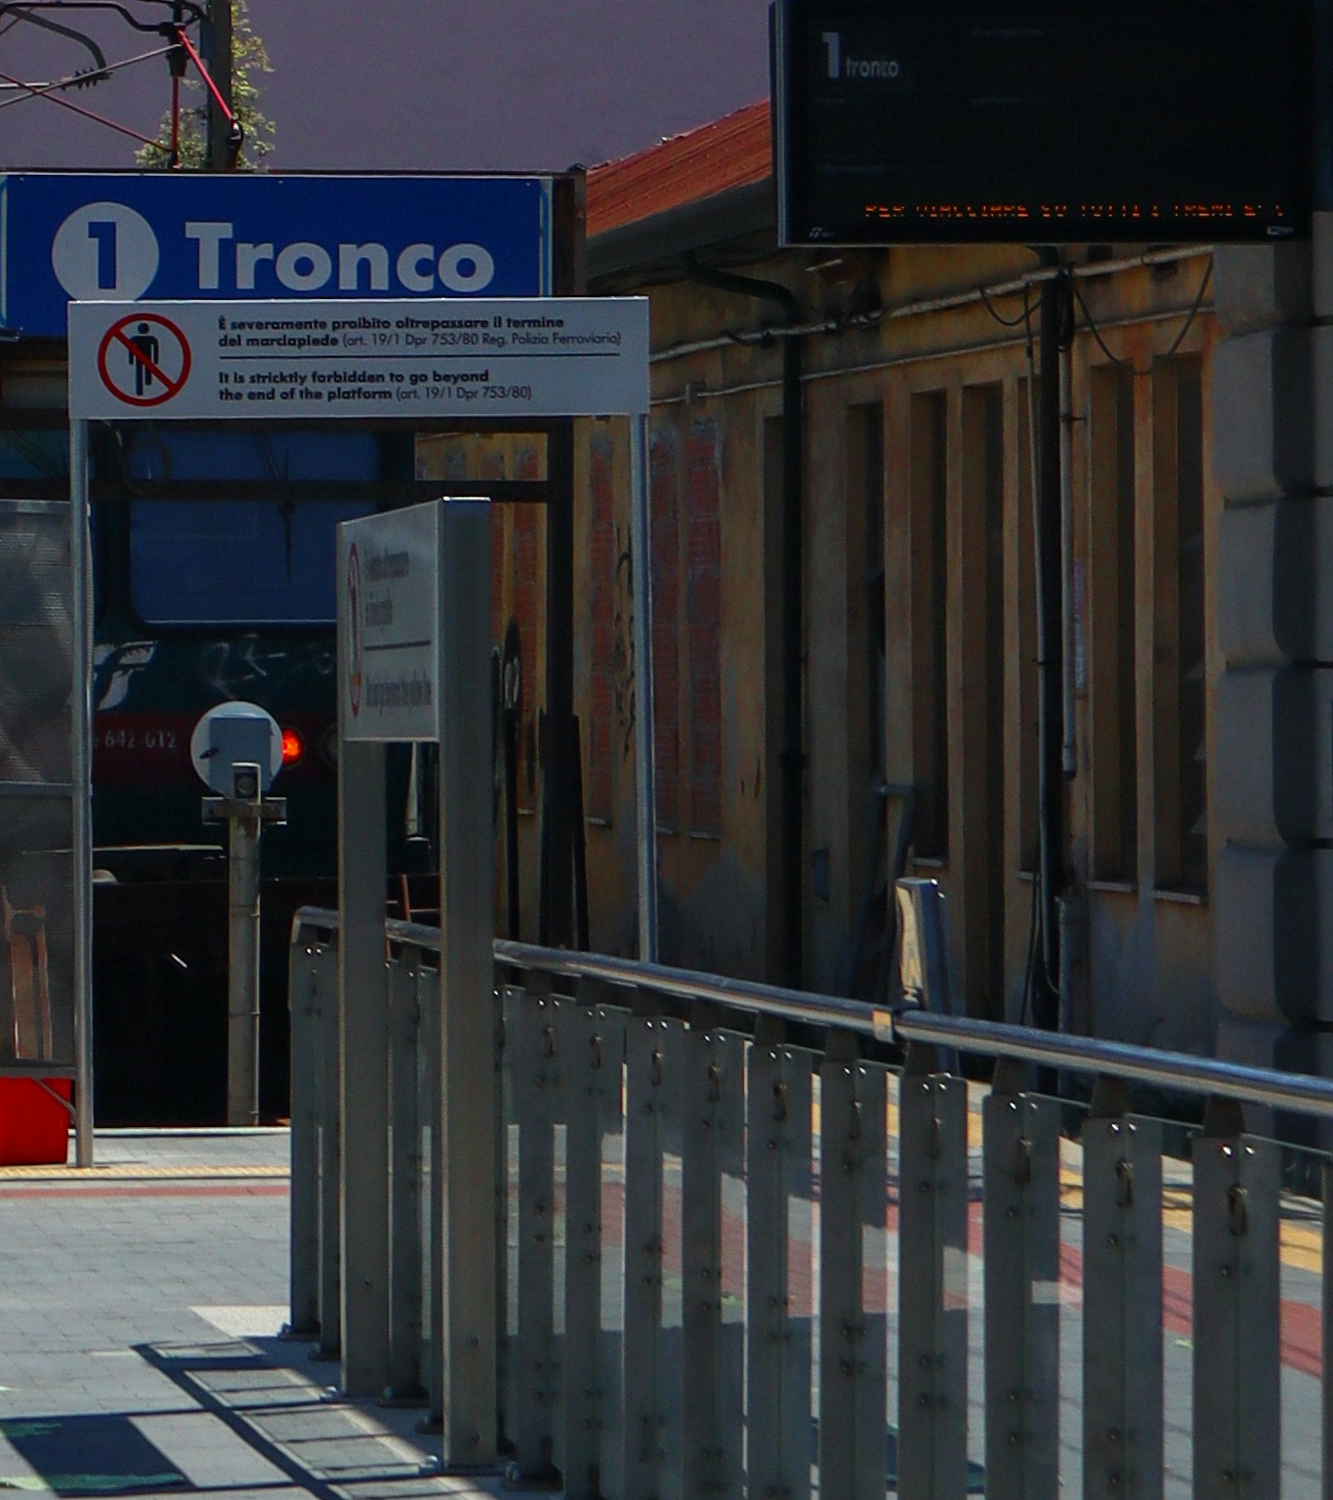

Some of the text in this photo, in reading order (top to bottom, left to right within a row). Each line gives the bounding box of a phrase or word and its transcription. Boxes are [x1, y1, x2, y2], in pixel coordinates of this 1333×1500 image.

[822, 31, 900, 79] 1 tronco
[87, 220, 496, 293] 1 Tronco
[230, 318, 329, 331] severamente
[332, 316, 392, 333] proibito
[395, 316, 490, 333] oltrepassare
[493, 316, 502, 328] il
[507, 315, 565, 329] termine
[218, 331, 623, 351] del marciapiede (art. 19/1 Dpr 753/80 Reg. Polizia Ferroviaria)
[219, 371, 230, 384] It
[234, 371, 245, 384] is
[311, 370, 386, 384] forbidden
[390, 371, 404, 383] to
[409, 374, 428, 386] go
[432, 369, 490, 386] beyond
[219, 385, 533, 403] the end of the platform (art. 19/1 Dpr 753/80)
